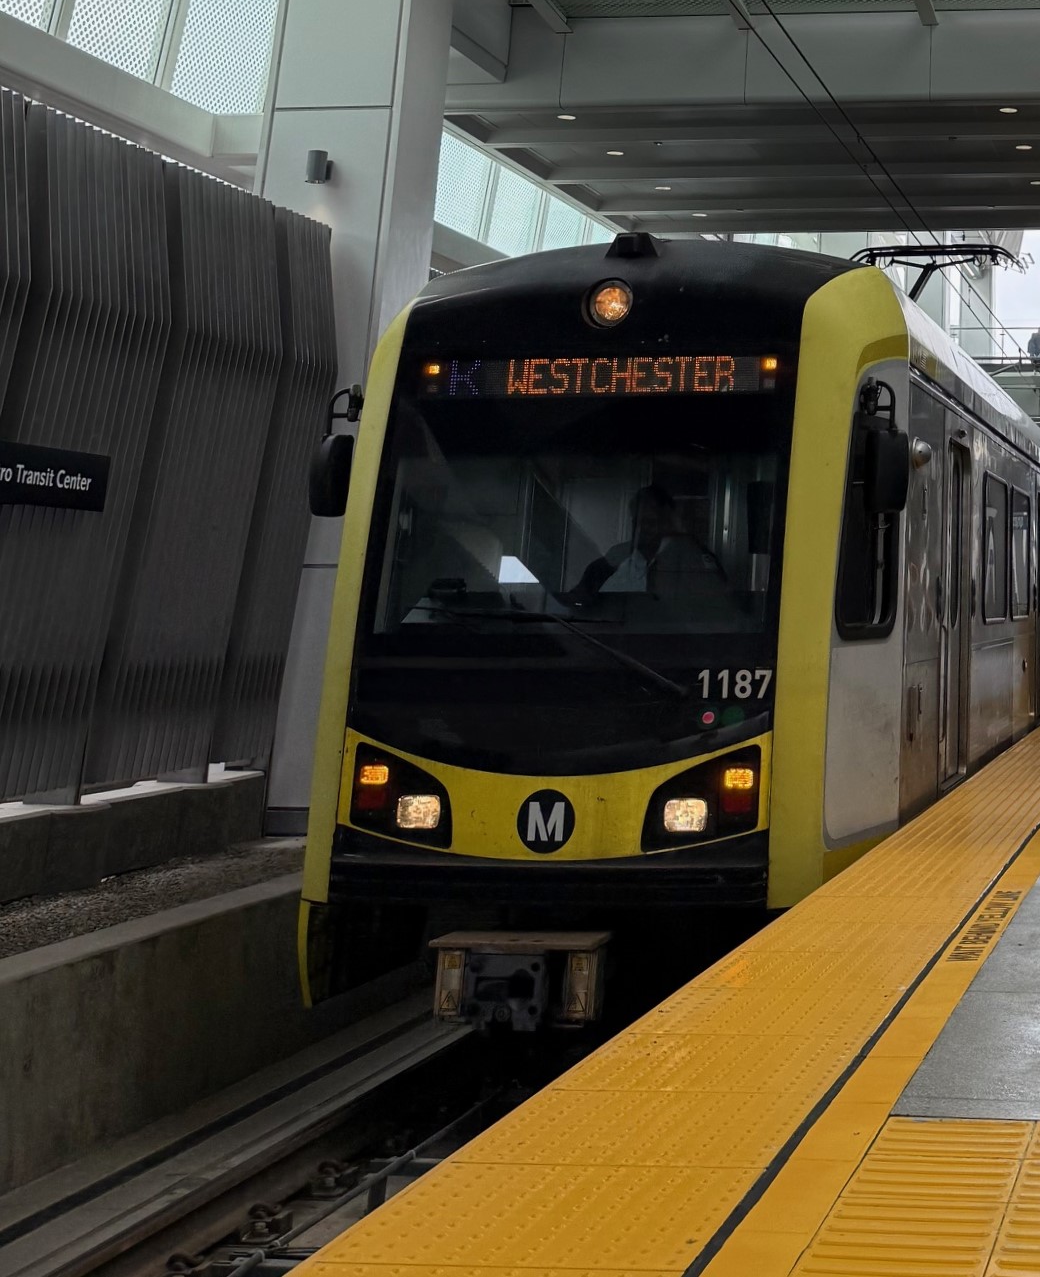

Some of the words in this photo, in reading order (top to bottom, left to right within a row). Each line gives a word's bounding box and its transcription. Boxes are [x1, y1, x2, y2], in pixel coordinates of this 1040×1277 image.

[449, 358, 481, 396] K
[507, 355, 736, 395] WESTCHESTER
[16, 464, 55, 487] Transit
[56, 469, 92, 491] Center
[698, 669, 773, 699] 1187
[526, 801, 566, 842] M
[974, 902, 1017, 923] YELLOW
[959, 923, 1001, 944] BEHIND
[945, 946, 986, 962] WAIT
